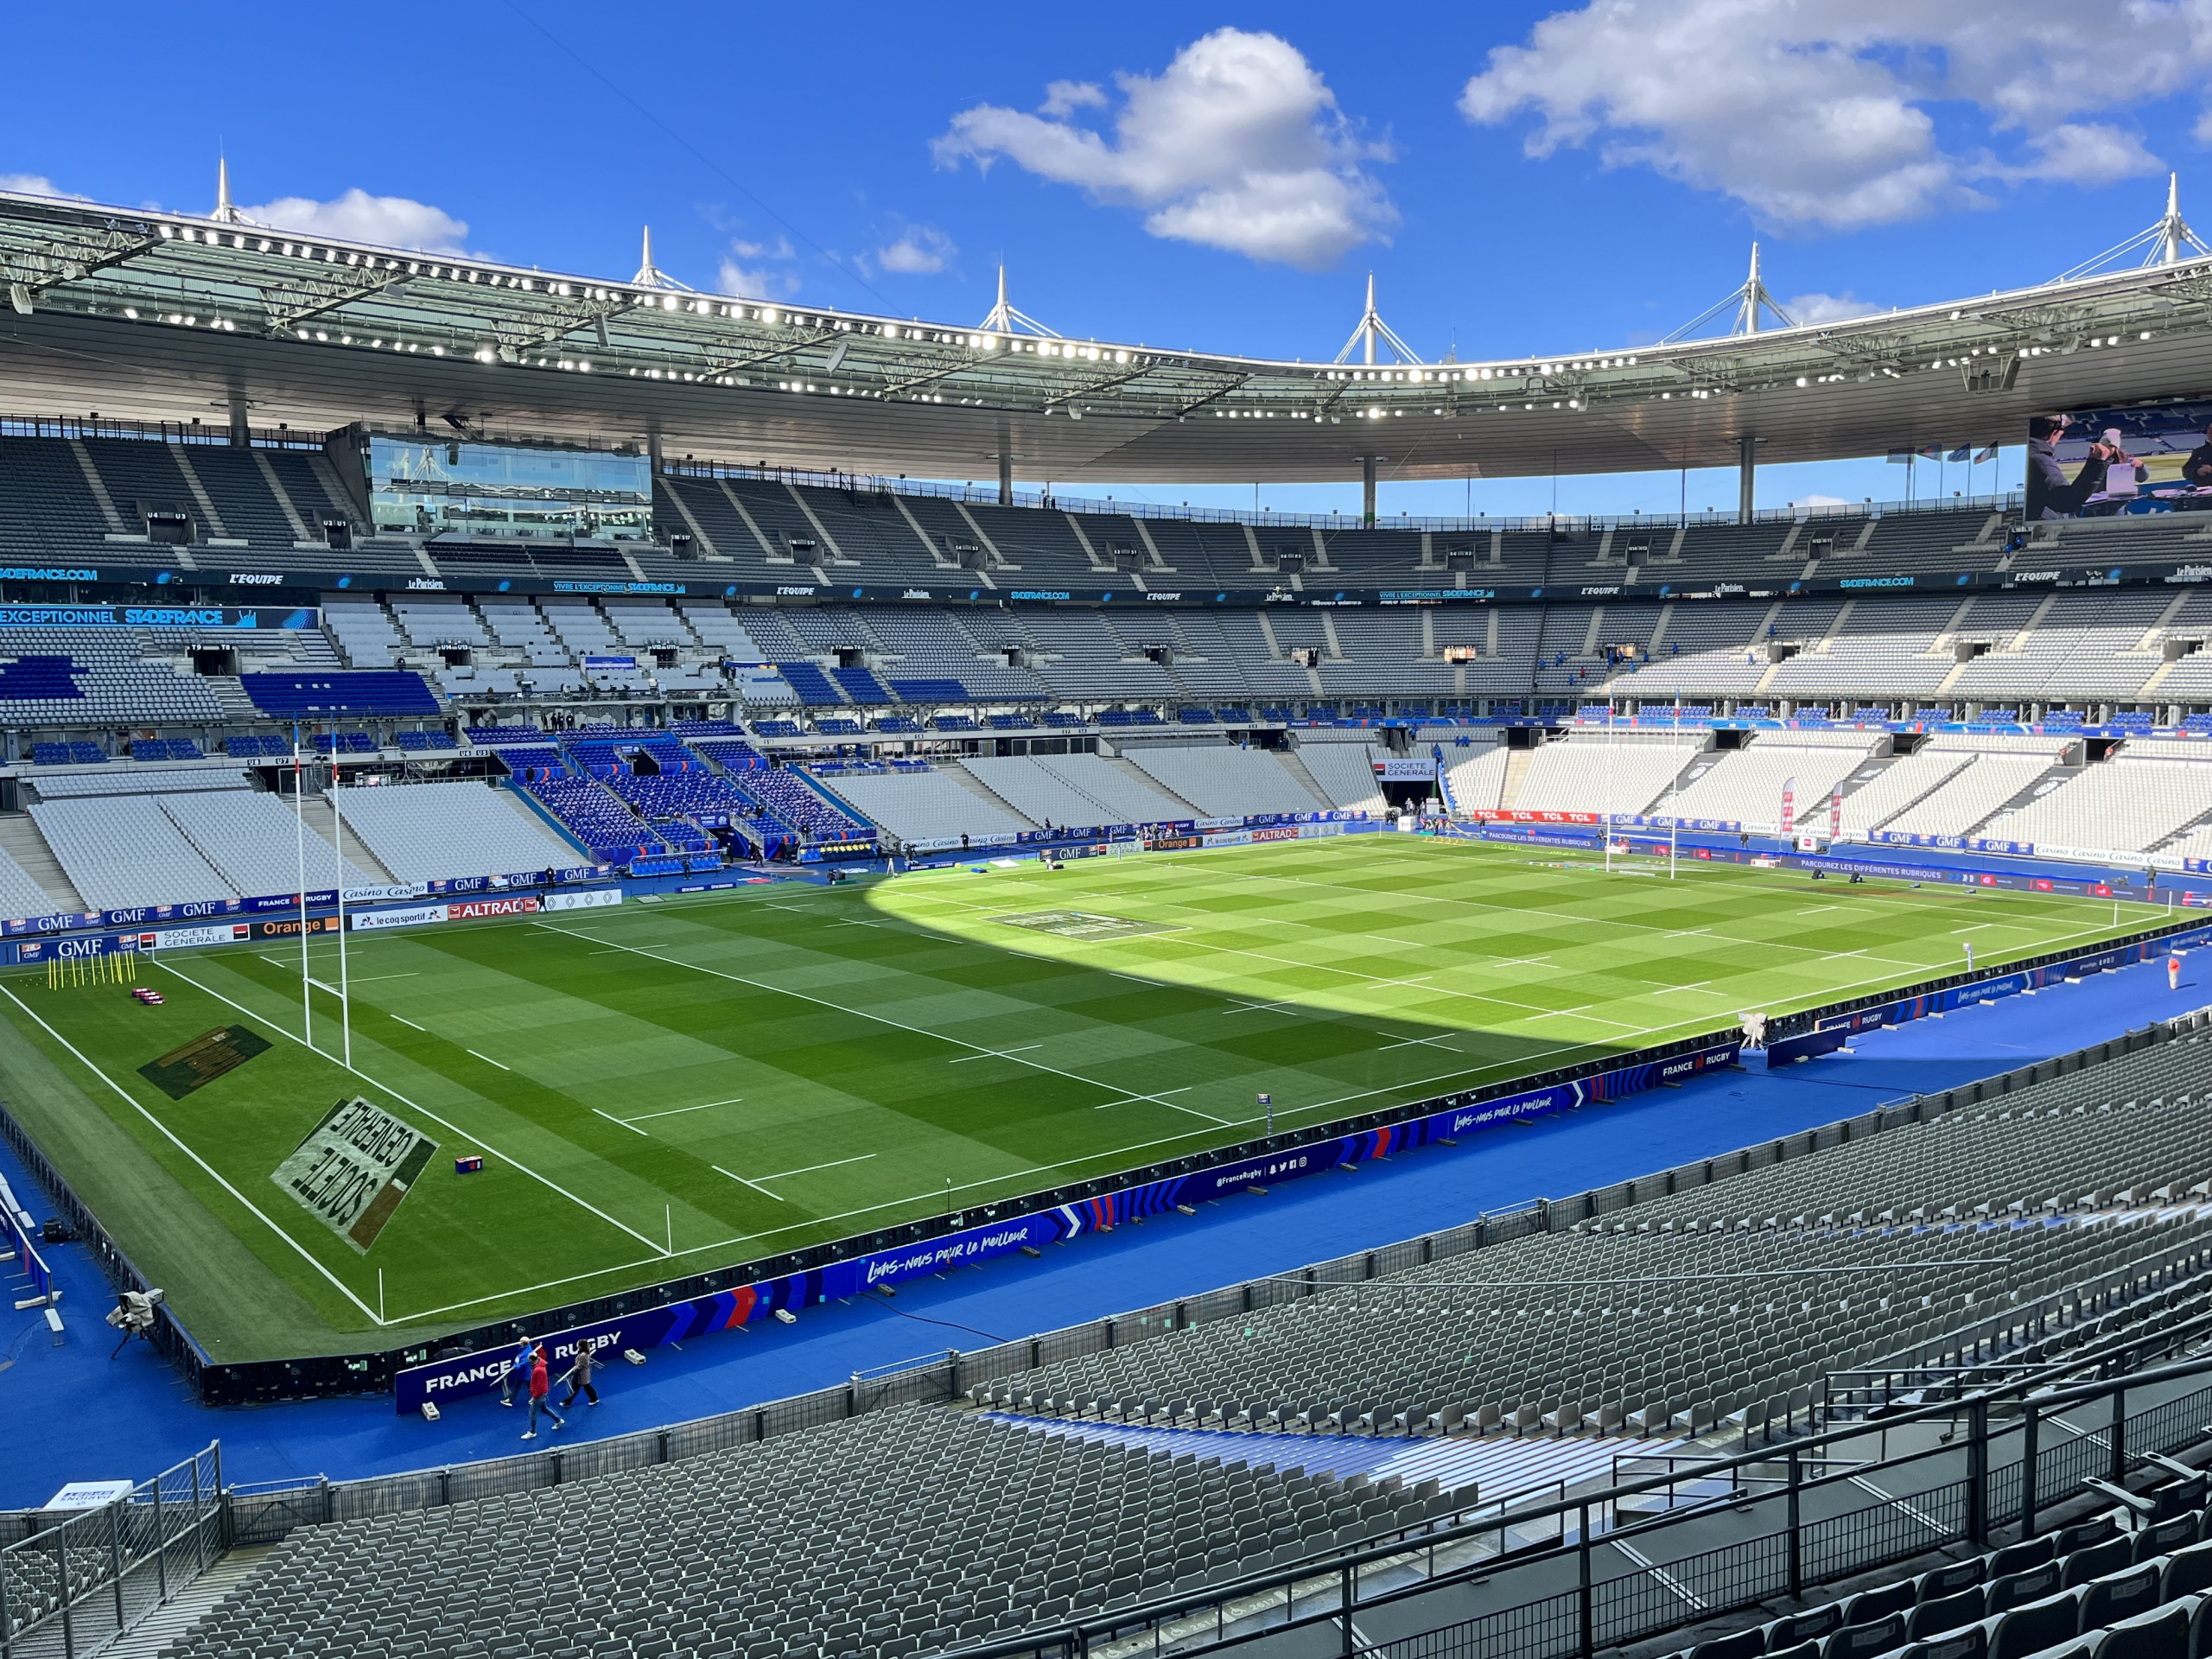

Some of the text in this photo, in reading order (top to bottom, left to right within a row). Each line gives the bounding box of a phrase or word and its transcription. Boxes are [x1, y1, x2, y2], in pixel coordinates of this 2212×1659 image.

[0, 568, 98, 582] ADEFRANCE.COM
[554, 582, 574, 591] VIVRE
[1840, 576, 1914, 588] STADEFRANCE.COM
[0, 609, 224, 626] EXCEPTIONNEL STADEFRANCE
[1196, 817, 1243, 827] Casino Casino
[1258, 814, 1276, 823] GMF
[1294, 812, 1313, 822] GMF
[1332, 811, 1351, 821] GMF
[1615, 815, 1637, 824] GMF
[1109, 825, 1128, 835] GMF
[1700, 819, 1720, 830] GMF
[1743, 823, 1770, 832] Casino
[1842, 830, 1866, 839] asino
[1035, 830, 1054, 841] GMF
[1073, 828, 1091, 838] GMF
[1259, 829, 1292, 841] ALTRAD
[1489, 832, 1516, 842] PARCOUREZ
[1561, 838, 1591, 847] RUBRIQUES
[1889, 833, 1912, 843] GMF
[933, 838, 959, 848] Casino
[990, 833, 1015, 844] Casino
[1159, 839, 1187, 849] Orange
[1936, 836, 1961, 848] GMF
[1986, 842, 2011, 852] GMF
[1059, 849, 1081, 860] GMF
[2036, 844, 2069, 855] Casino
[2072, 848, 2105, 858] Casino
[2108, 850, 2143, 861] Casino
[2146, 855, 2180, 867] Casino
[564, 868, 590, 880] GMF
[1801, 860, 1840, 870] PARCOUREZ
[1853, 863, 1900, 875] DIFFÉRENTES
[1901, 868, 1942, 880] RUBRIQUES
[454, 878, 482, 891] GMF
[511, 872, 537, 886] GMF
[343, 887, 382, 899] Casino
[183, 902, 216, 917] GMF
[258, 899, 290, 907] FRANCE
[462, 901, 524, 918] ALTRAD
[111, 909, 146, 924] GMF
[377, 913, 426, 926] le coq sportif
[39, 916, 73, 931] GMF
[264, 919, 321, 936] Orange
[164, 928, 214, 939] SOCIETE
[164, 934, 226, 947] GENERALE
[58, 939, 103, 957] GMF
[1861, 1013, 1882, 1025] RUGBY
[1662, 1051, 1731, 1077] FRANCE RUGBY
[329, 1100, 414, 1168] GENERALE
[1217, 1168, 1262, 1187] @FranceRugby
[290, 1146, 378, 1227] SOCIETE
[426, 1359, 512, 1394] FRANCE
[1362, 1560, 1388, 1573] 2619
[1306, 1578, 1333, 1592] 2618
[1249, 1597, 1274, 1611] 2617
[1189, 1616, 1219, 1632] 2616
